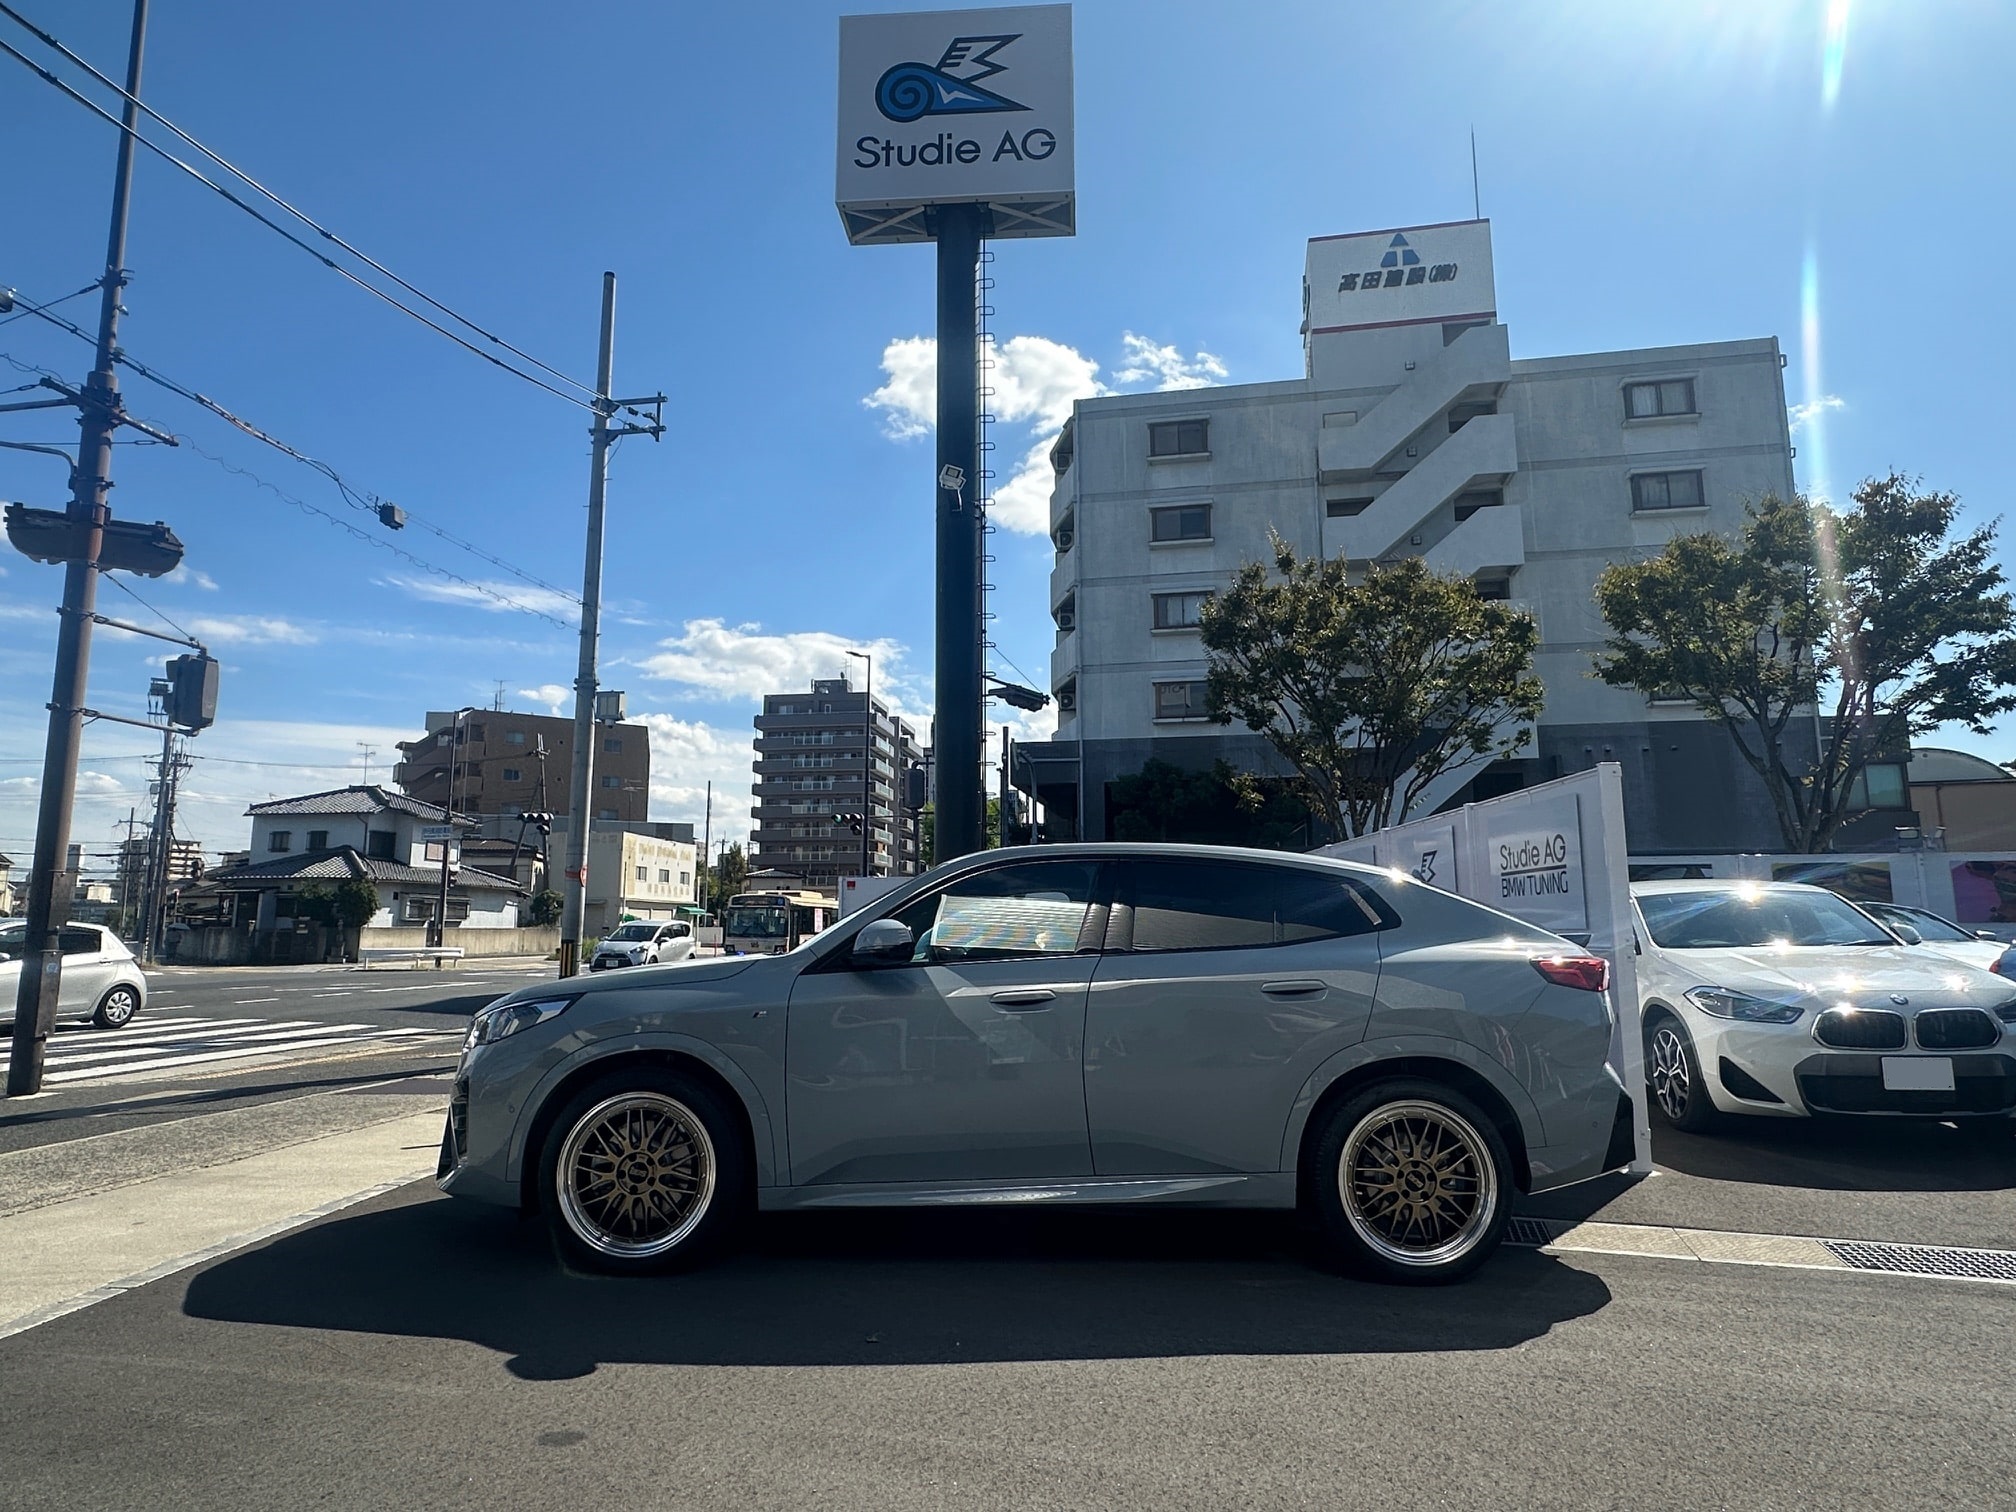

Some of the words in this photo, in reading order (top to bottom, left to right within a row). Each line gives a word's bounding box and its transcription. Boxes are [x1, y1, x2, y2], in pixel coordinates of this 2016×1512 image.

[854, 132, 981, 168] Studie
[992, 128, 1056, 162] AG
[1500, 840, 1540, 870] Studie
[1544, 834, 1566, 863] AG
[1502, 876, 1525, 898] BMW
[1526, 871, 1568, 896] TUNING
